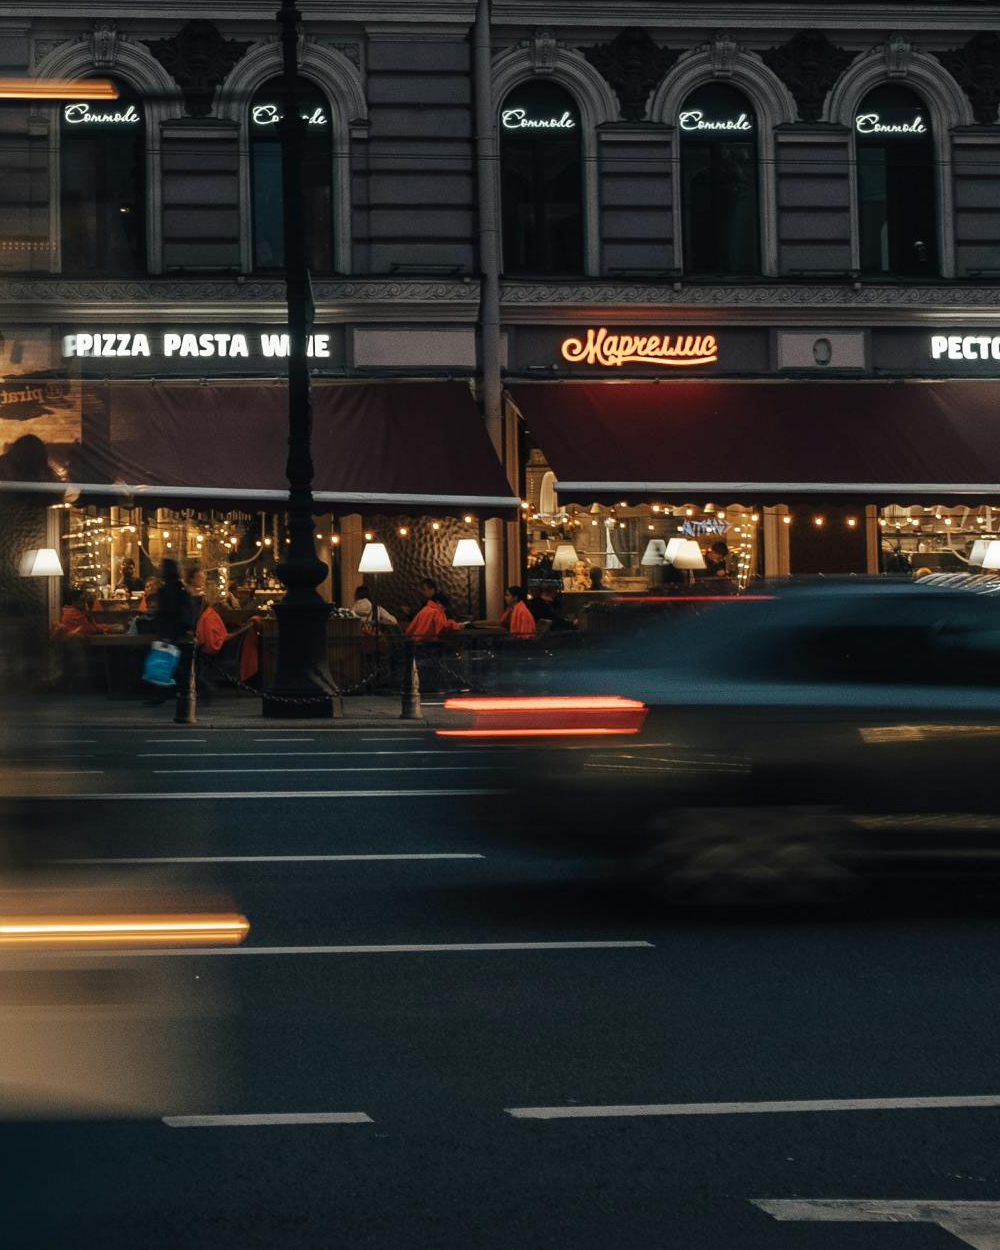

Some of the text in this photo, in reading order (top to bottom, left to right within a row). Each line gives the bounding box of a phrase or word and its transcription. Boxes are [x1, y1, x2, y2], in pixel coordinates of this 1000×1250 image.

[65, 103, 140, 123] Commode
[502, 109, 575, 128] Commode
[679, 111, 752, 130] Commode
[856, 113, 927, 133] Commode
[76, 333, 150, 357] PIZZA
[163, 333, 249, 357] PASTA
